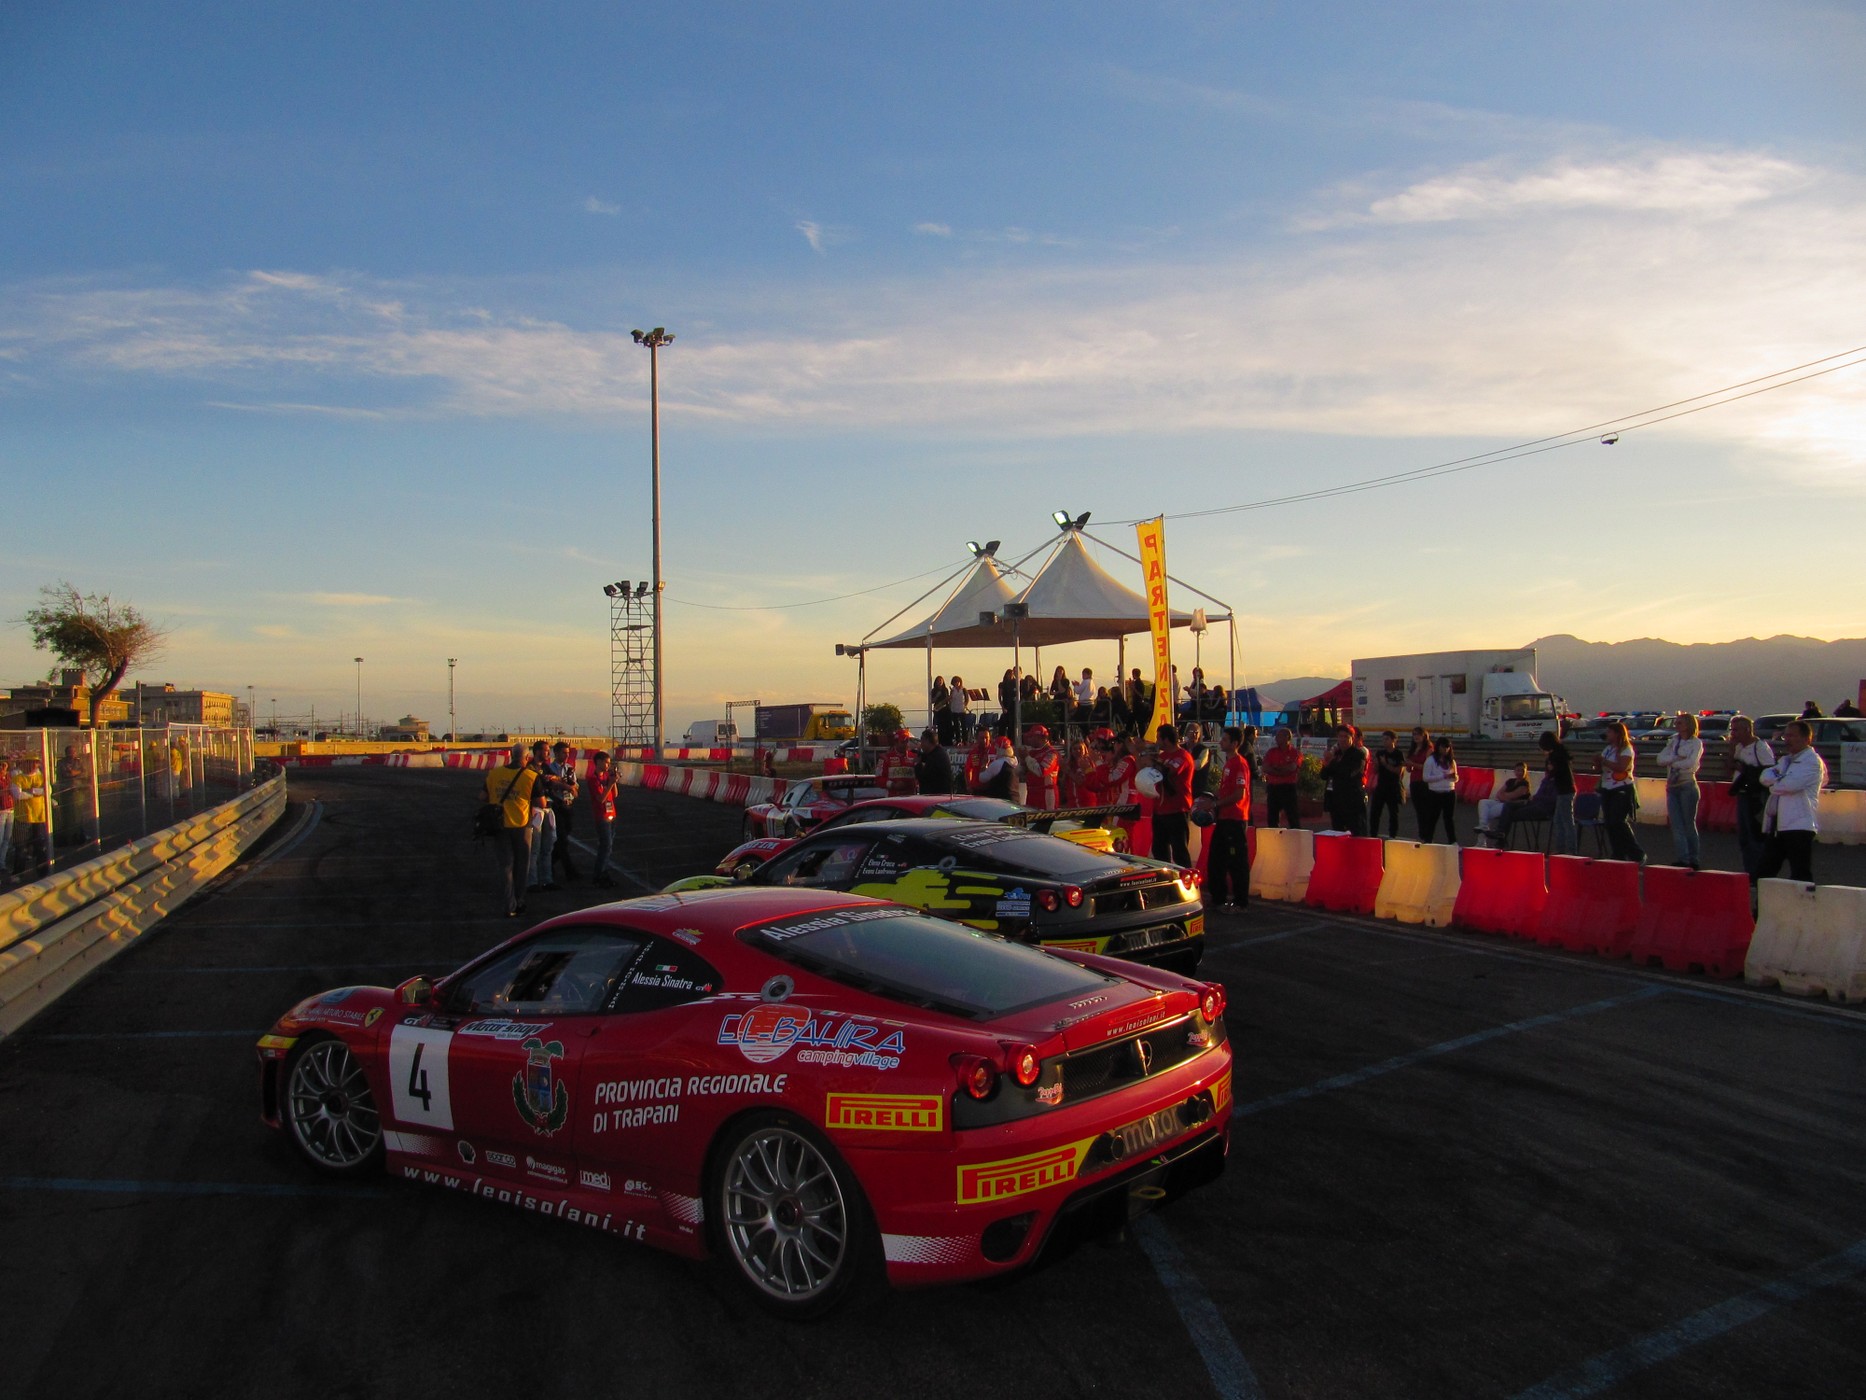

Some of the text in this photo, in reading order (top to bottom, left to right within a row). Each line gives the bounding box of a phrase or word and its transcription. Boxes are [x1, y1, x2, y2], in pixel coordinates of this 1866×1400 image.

[760, 913, 849, 941] Alessia
[631, 972, 661, 986] Alessia
[661, 974, 693, 990] Sinatra
[717, 1014, 906, 1053] EL-BAHIRA
[797, 1050, 900, 1069] campingvillage
[409, 1042, 432, 1111] 4
[594, 1073, 788, 1105] PROVINCIA REGIONALE
[593, 1104, 680, 1133] DI TRAPANI
[829, 1097, 938, 1127] PIRELLI
[962, 1147, 1077, 1199] PIRELLI
